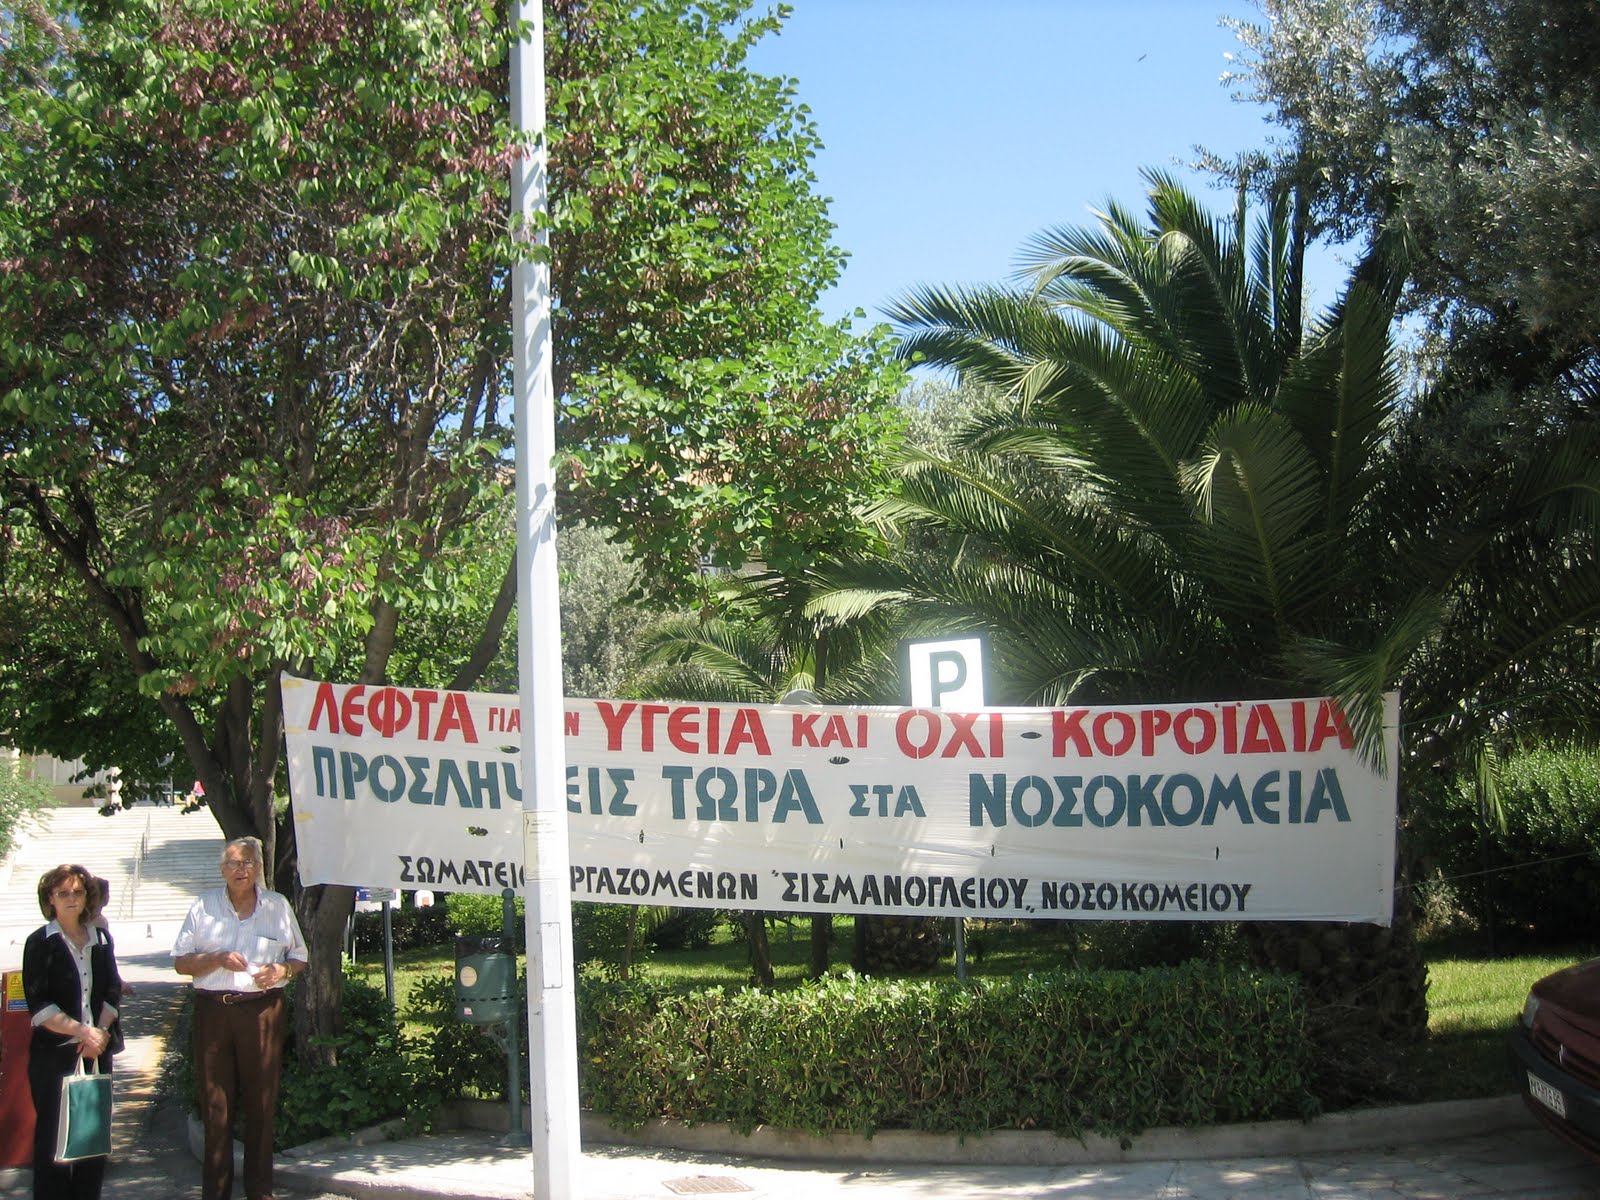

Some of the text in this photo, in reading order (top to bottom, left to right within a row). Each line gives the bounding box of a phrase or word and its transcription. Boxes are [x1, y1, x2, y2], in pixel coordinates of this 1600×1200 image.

[929, 651, 968, 708] P
[308, 682, 478, 743] ΛΕΦΤΑ
[488, 707, 521, 733] ΓΙΑ
[594, 701, 771, 756] ΥΓΕΙΑ
[792, 713, 868, 748] ΚΑΙ
[895, 709, 1004, 759] ΟΧΙ
[1052, 700, 1355, 758] ΚΟΡΟΪΔΙΑ
[662, 765, 823, 824] ΤΩΡΑ
[848, 784, 926, 818] ΣΤΑ
[969, 768, 1351, 828] ΝΟΣΟΚΟΜΕΙΑ
[570, 865, 758, 900] ΡΓΑΖΟΜΕΝΩΝ
[1041, 881, 1253, 913] ΝΟΣΟΚΟΜΕΙΟΥ
